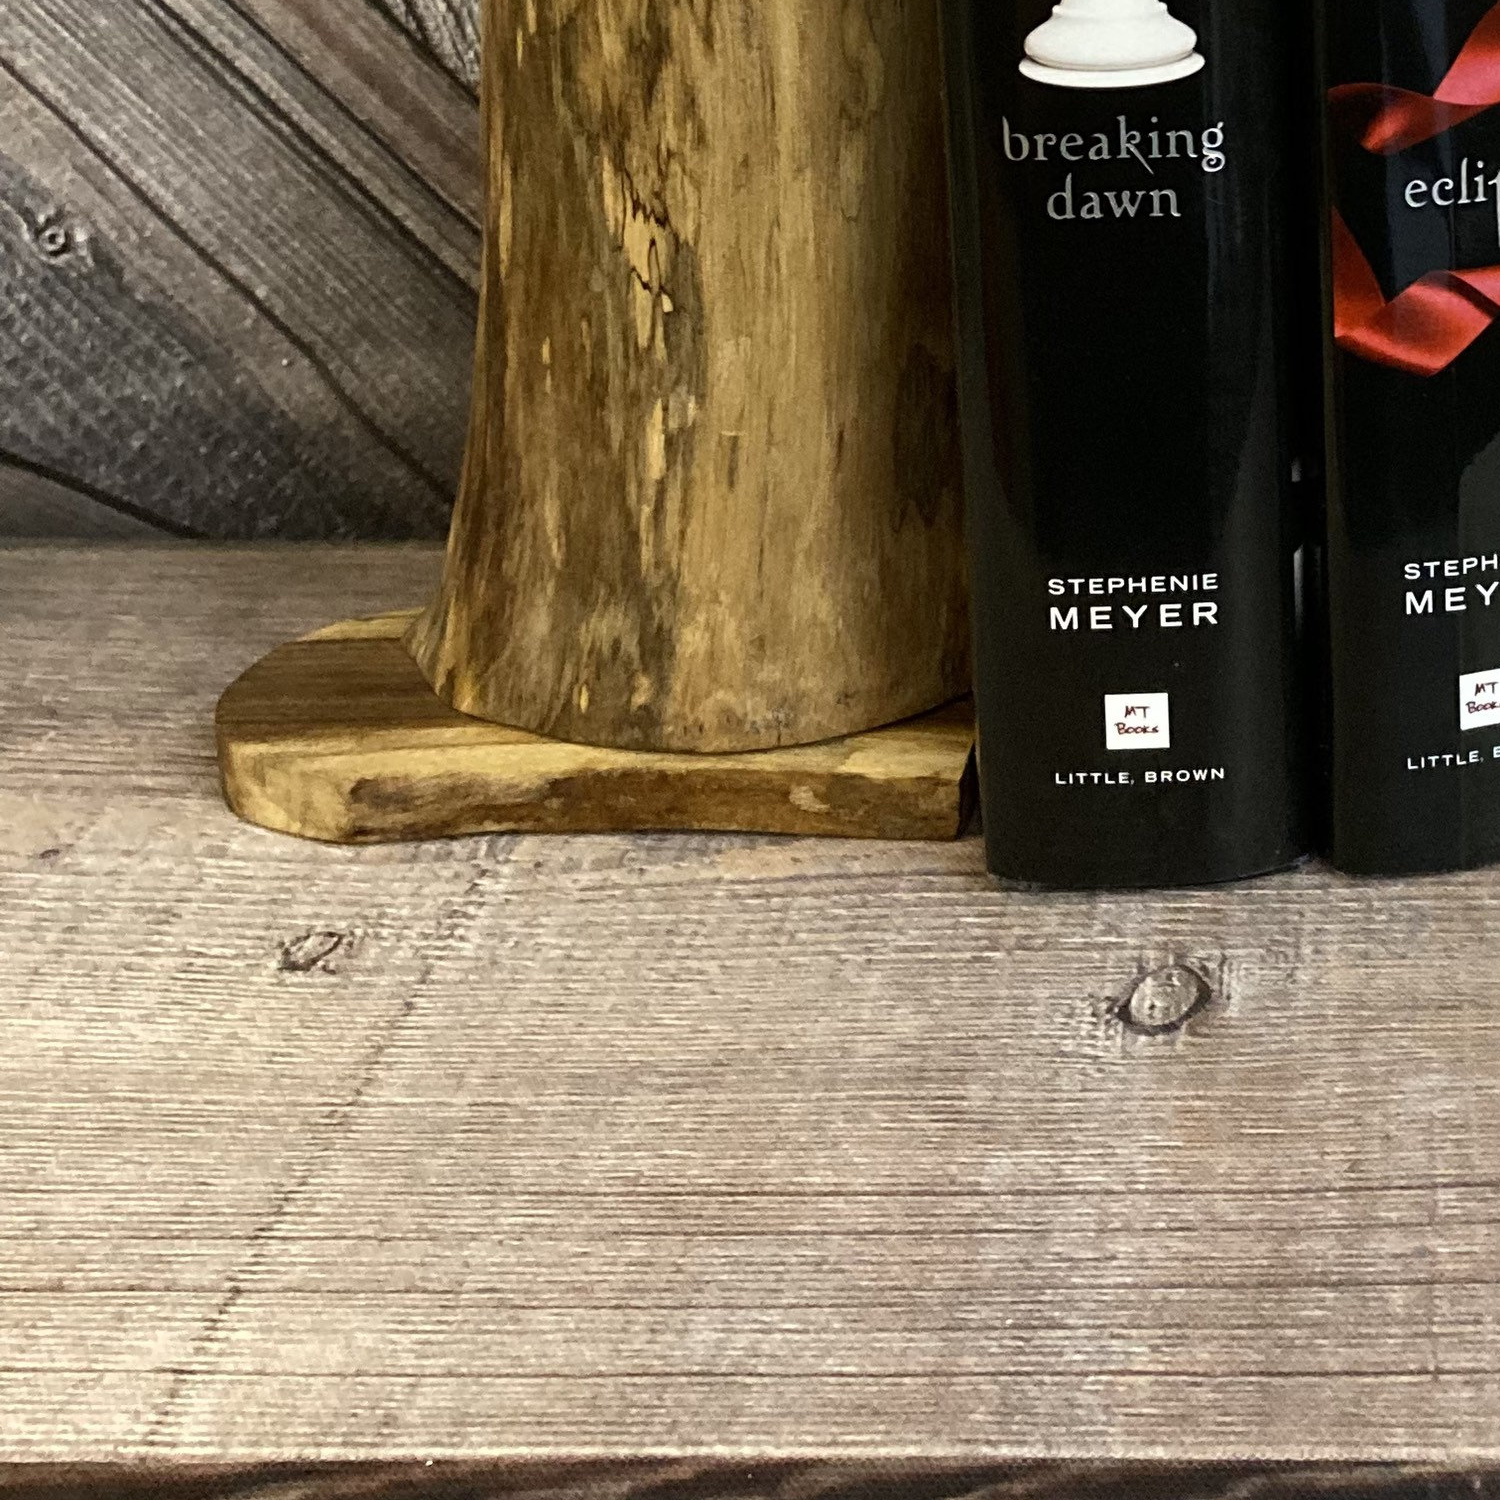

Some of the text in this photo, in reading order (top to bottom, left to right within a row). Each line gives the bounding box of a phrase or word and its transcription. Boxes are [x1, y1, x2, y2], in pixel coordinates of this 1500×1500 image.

[1002, 115, 1226, 175] breaking
[1046, 172, 1182, 220] dawn
[1048, 573, 1219, 595] STEPHENIE
[1050, 601, 1219, 630] MEYER
[1474, 682, 1499, 696] MT
[1124, 705, 1150, 718] MT
[1407, 750, 1484, 770] LITTLE,
[1055, 767, 1225, 785] LITTLE, BROWN
